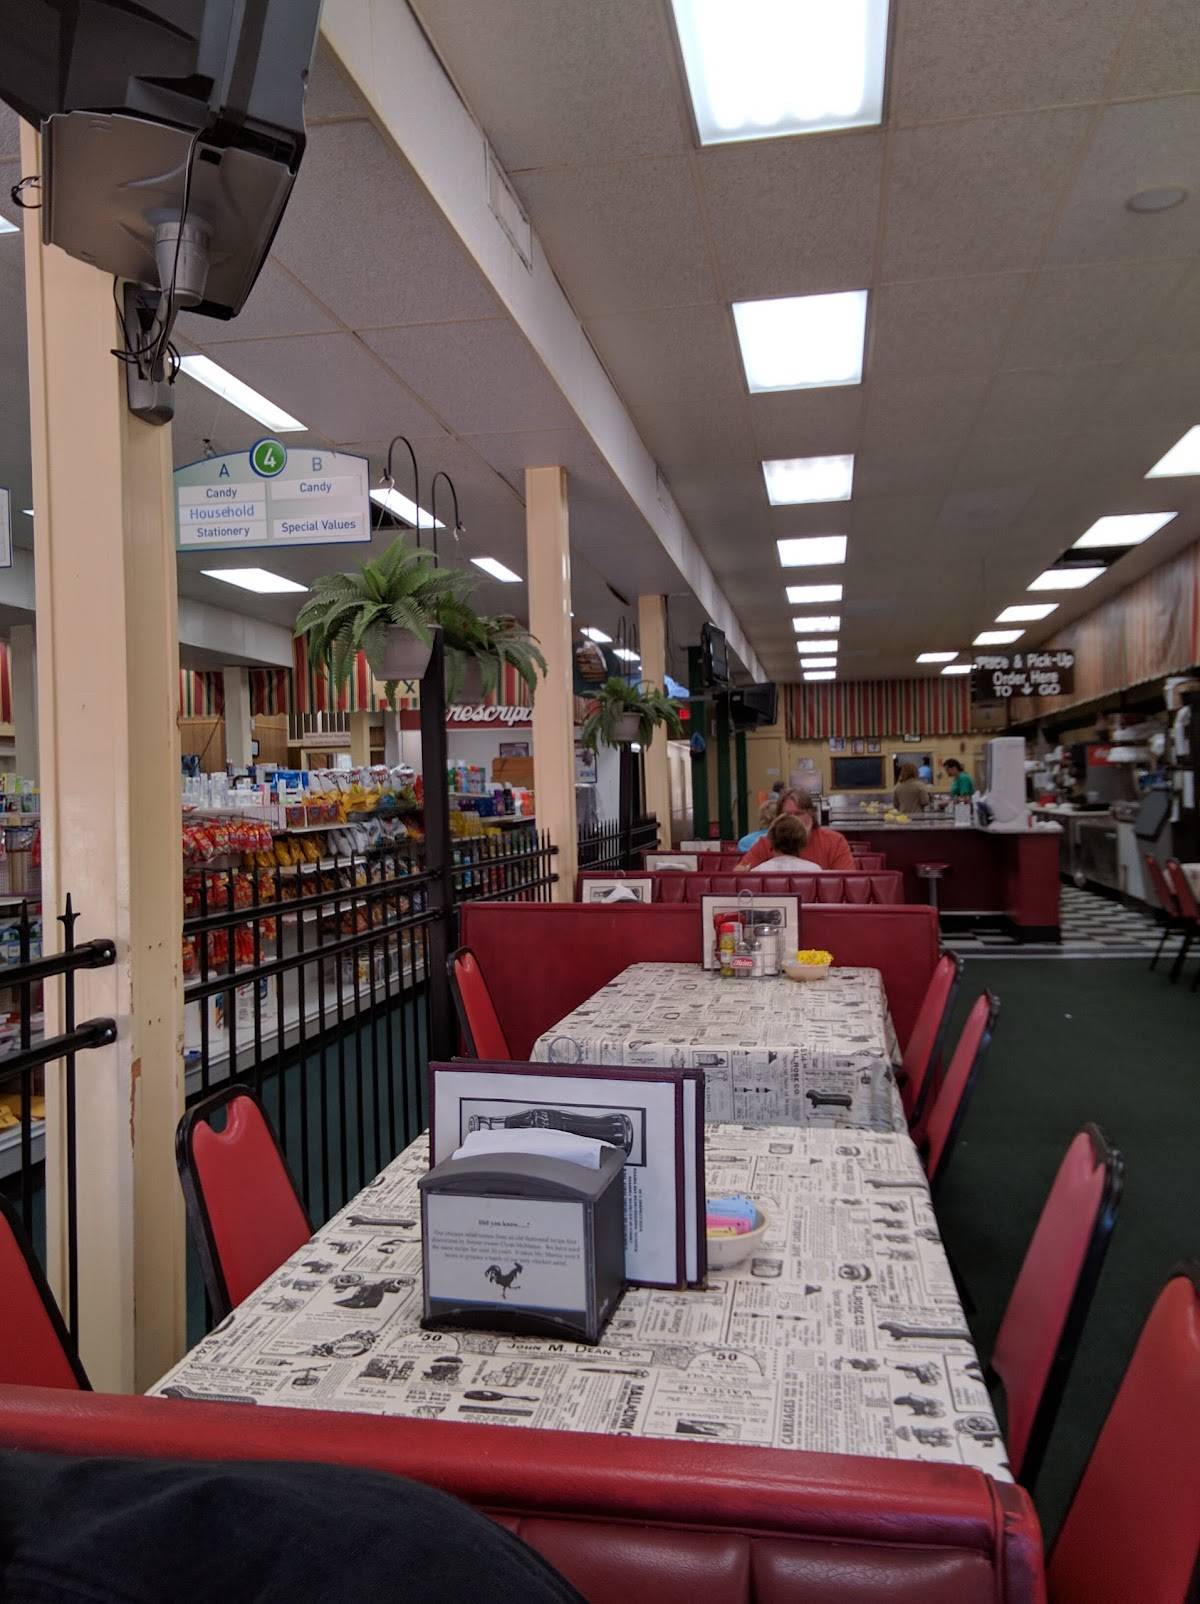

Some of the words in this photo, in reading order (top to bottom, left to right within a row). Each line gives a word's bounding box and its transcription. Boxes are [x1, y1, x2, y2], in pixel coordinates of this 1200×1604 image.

[264, 447, 276, 468] 4
[312, 457, 322, 472] B
[218, 463, 230, 477] A
[206, 487, 237, 500] Candy
[299, 481, 332, 494] Candy
[190, 505, 254, 520] Household
[197, 526, 250, 538] Stationery
[281, 522, 319, 534] Special
[321, 519, 356, 531] Values
[992, 671, 1027, 685] Order
[1030, 670, 1059, 684] Here
